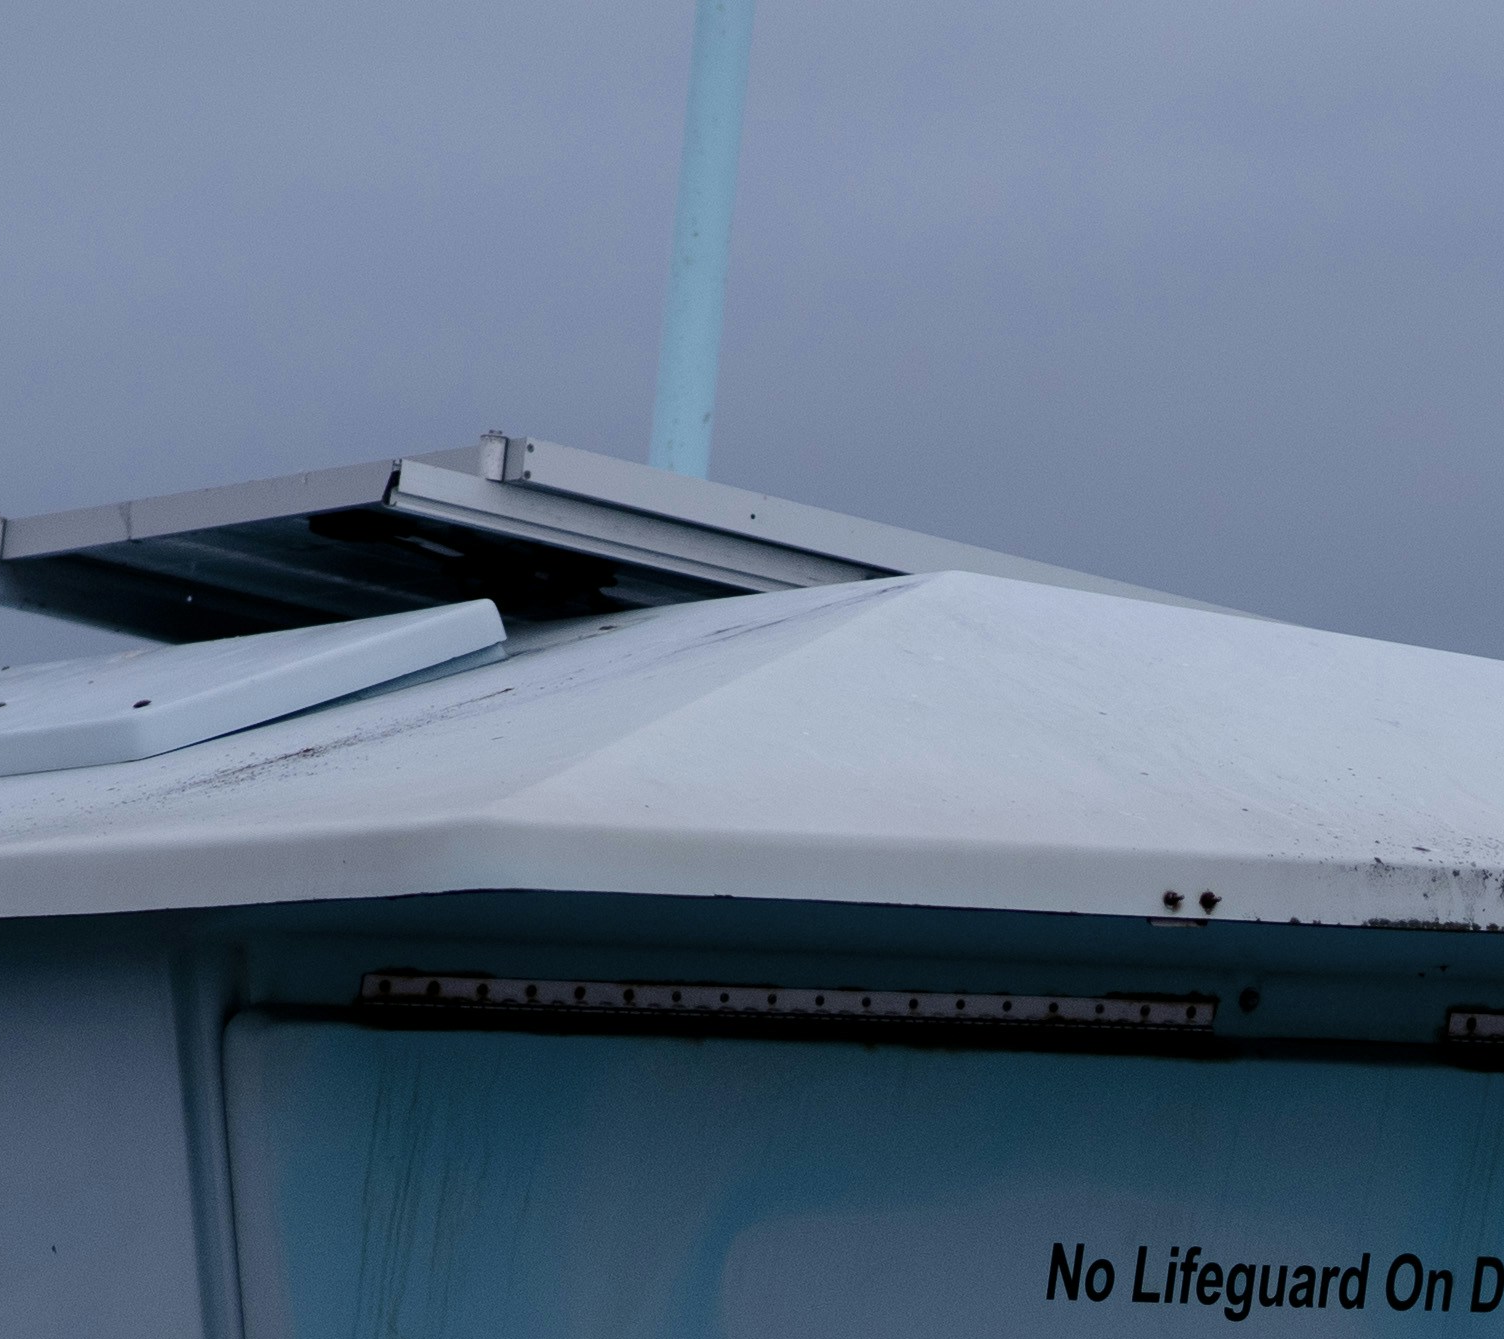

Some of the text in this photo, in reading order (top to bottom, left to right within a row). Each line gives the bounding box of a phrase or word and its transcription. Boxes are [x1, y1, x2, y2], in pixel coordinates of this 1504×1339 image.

[1046, 1243, 1115, 1302] No
[1132, 1246, 1371, 1322] Lifeguard
[1386, 1253, 1453, 1312] On
